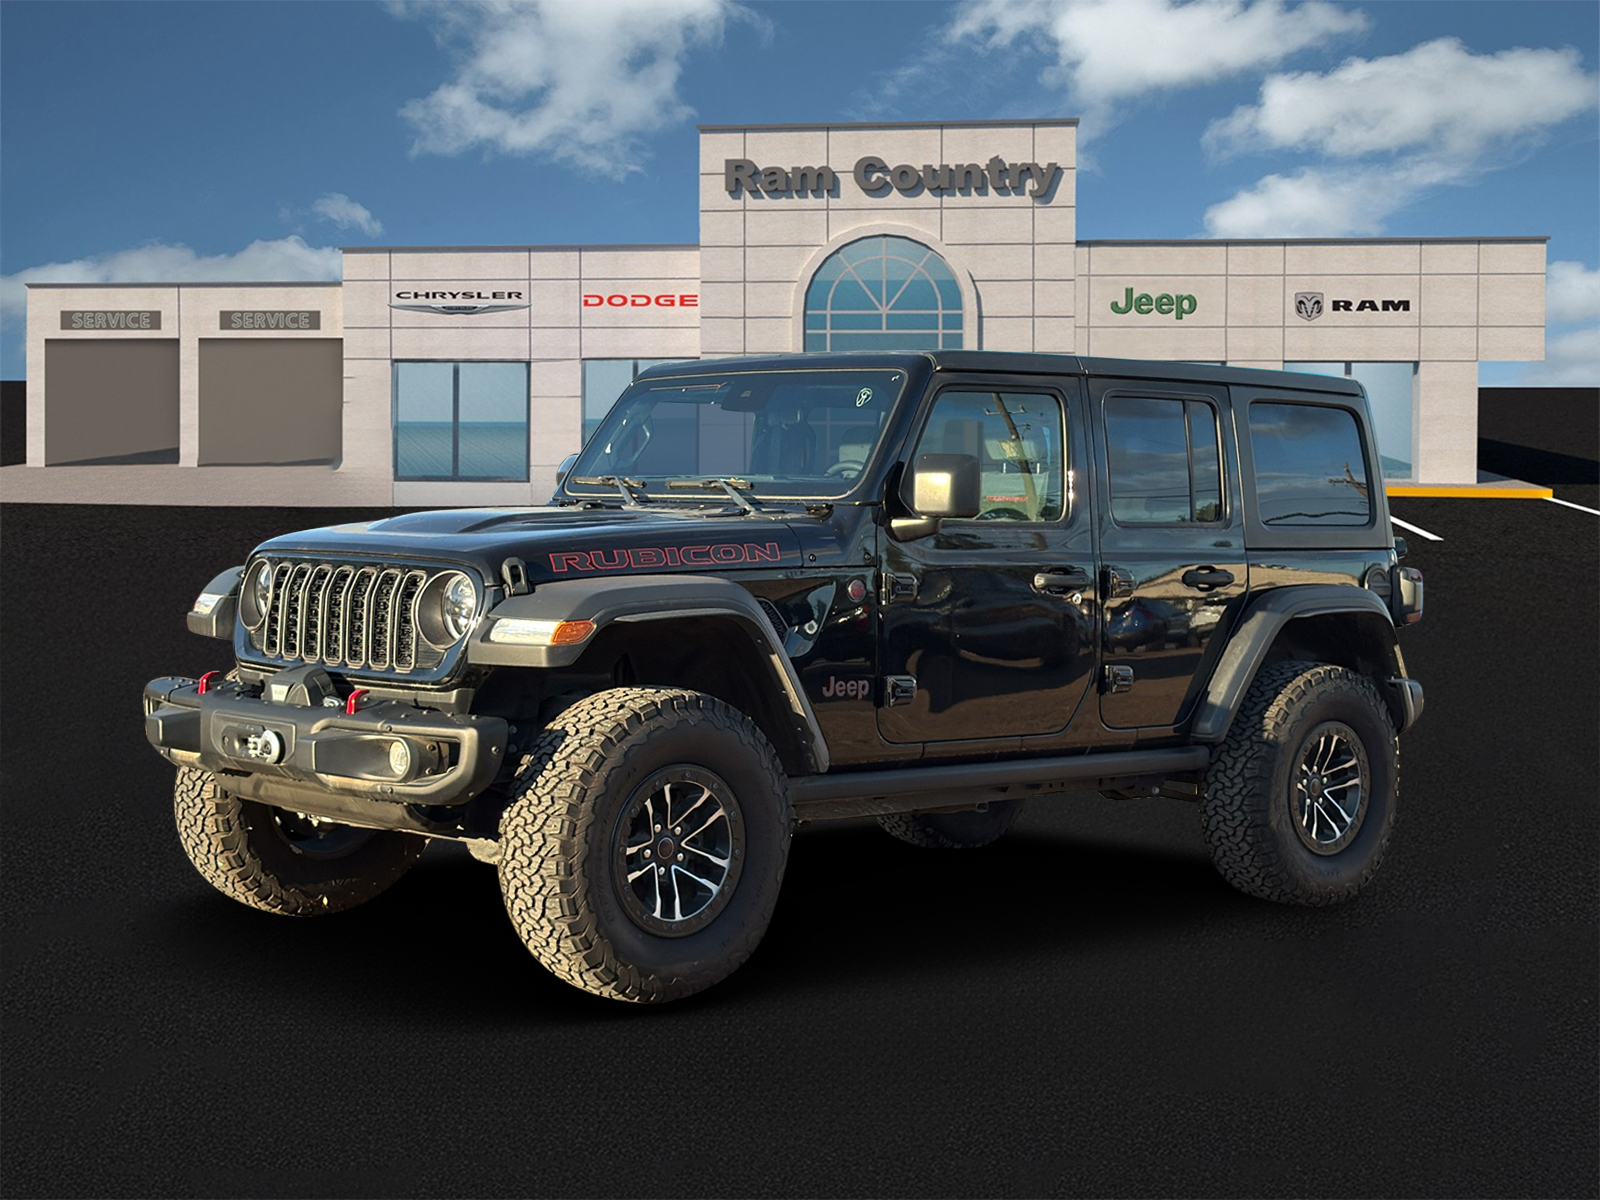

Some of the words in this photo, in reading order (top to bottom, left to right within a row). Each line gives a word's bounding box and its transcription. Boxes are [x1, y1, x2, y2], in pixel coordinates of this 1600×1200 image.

[724, 159, 834, 192] Ram
[853, 155, 1058, 197] Country
[395, 291, 523, 300] CHRYSLER
[583, 295, 698, 307] DODGE
[1110, 287, 1196, 320] Jeep
[1333, 300, 1410, 311] RAM
[72, 312, 151, 328] SERVICE
[231, 312, 310, 328] SERVICE
[549, 542, 781, 572] RUBICON
[822, 676, 869, 699] Jeep
